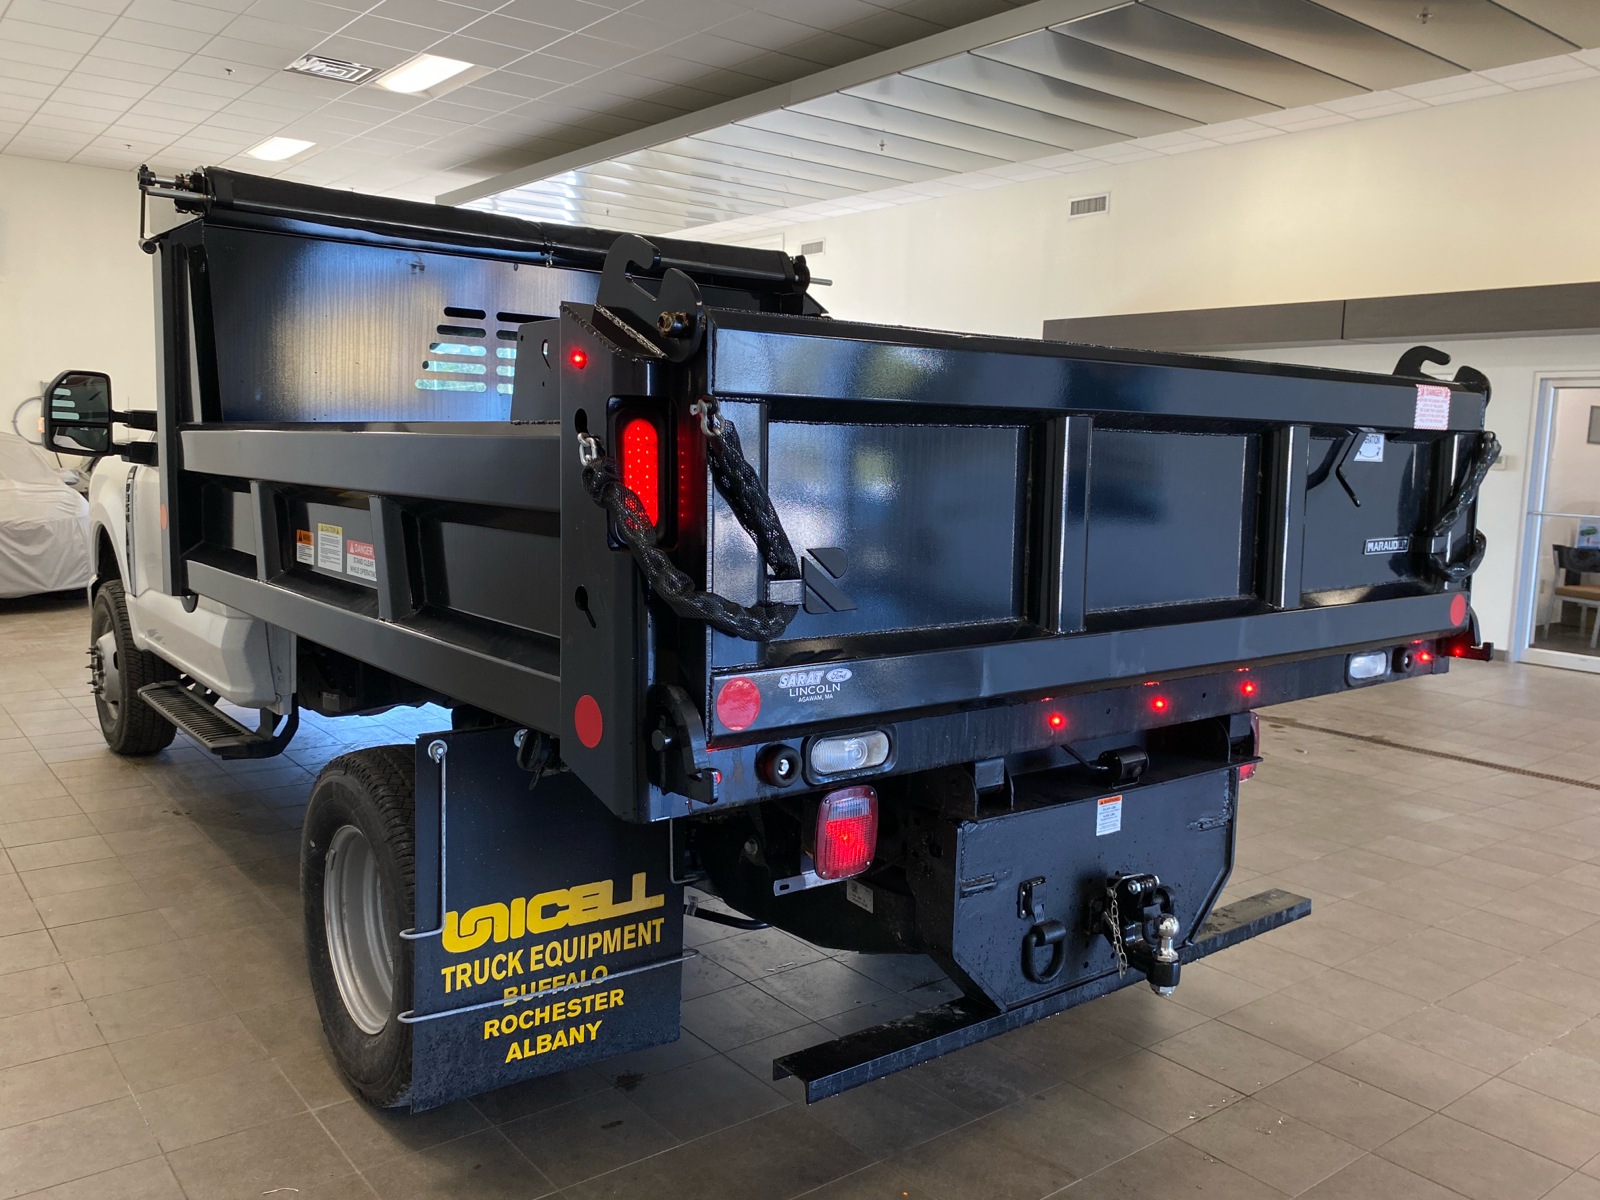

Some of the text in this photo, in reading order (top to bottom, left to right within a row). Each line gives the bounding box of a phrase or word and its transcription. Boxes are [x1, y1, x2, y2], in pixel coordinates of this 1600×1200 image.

[354, 543, 374, 556] DANGER
[778, 668, 850, 688] SARAT Ford
[789, 683, 840, 697] LINCOLN
[441, 872, 665, 953] UNICELL
[441, 917, 665, 993] TRUCK EQUIPMENT
[503, 965, 609, 1007] BUFFALO
[483, 988, 625, 1040] ROCHESTER
[504, 1020, 602, 1064] ALBANY
